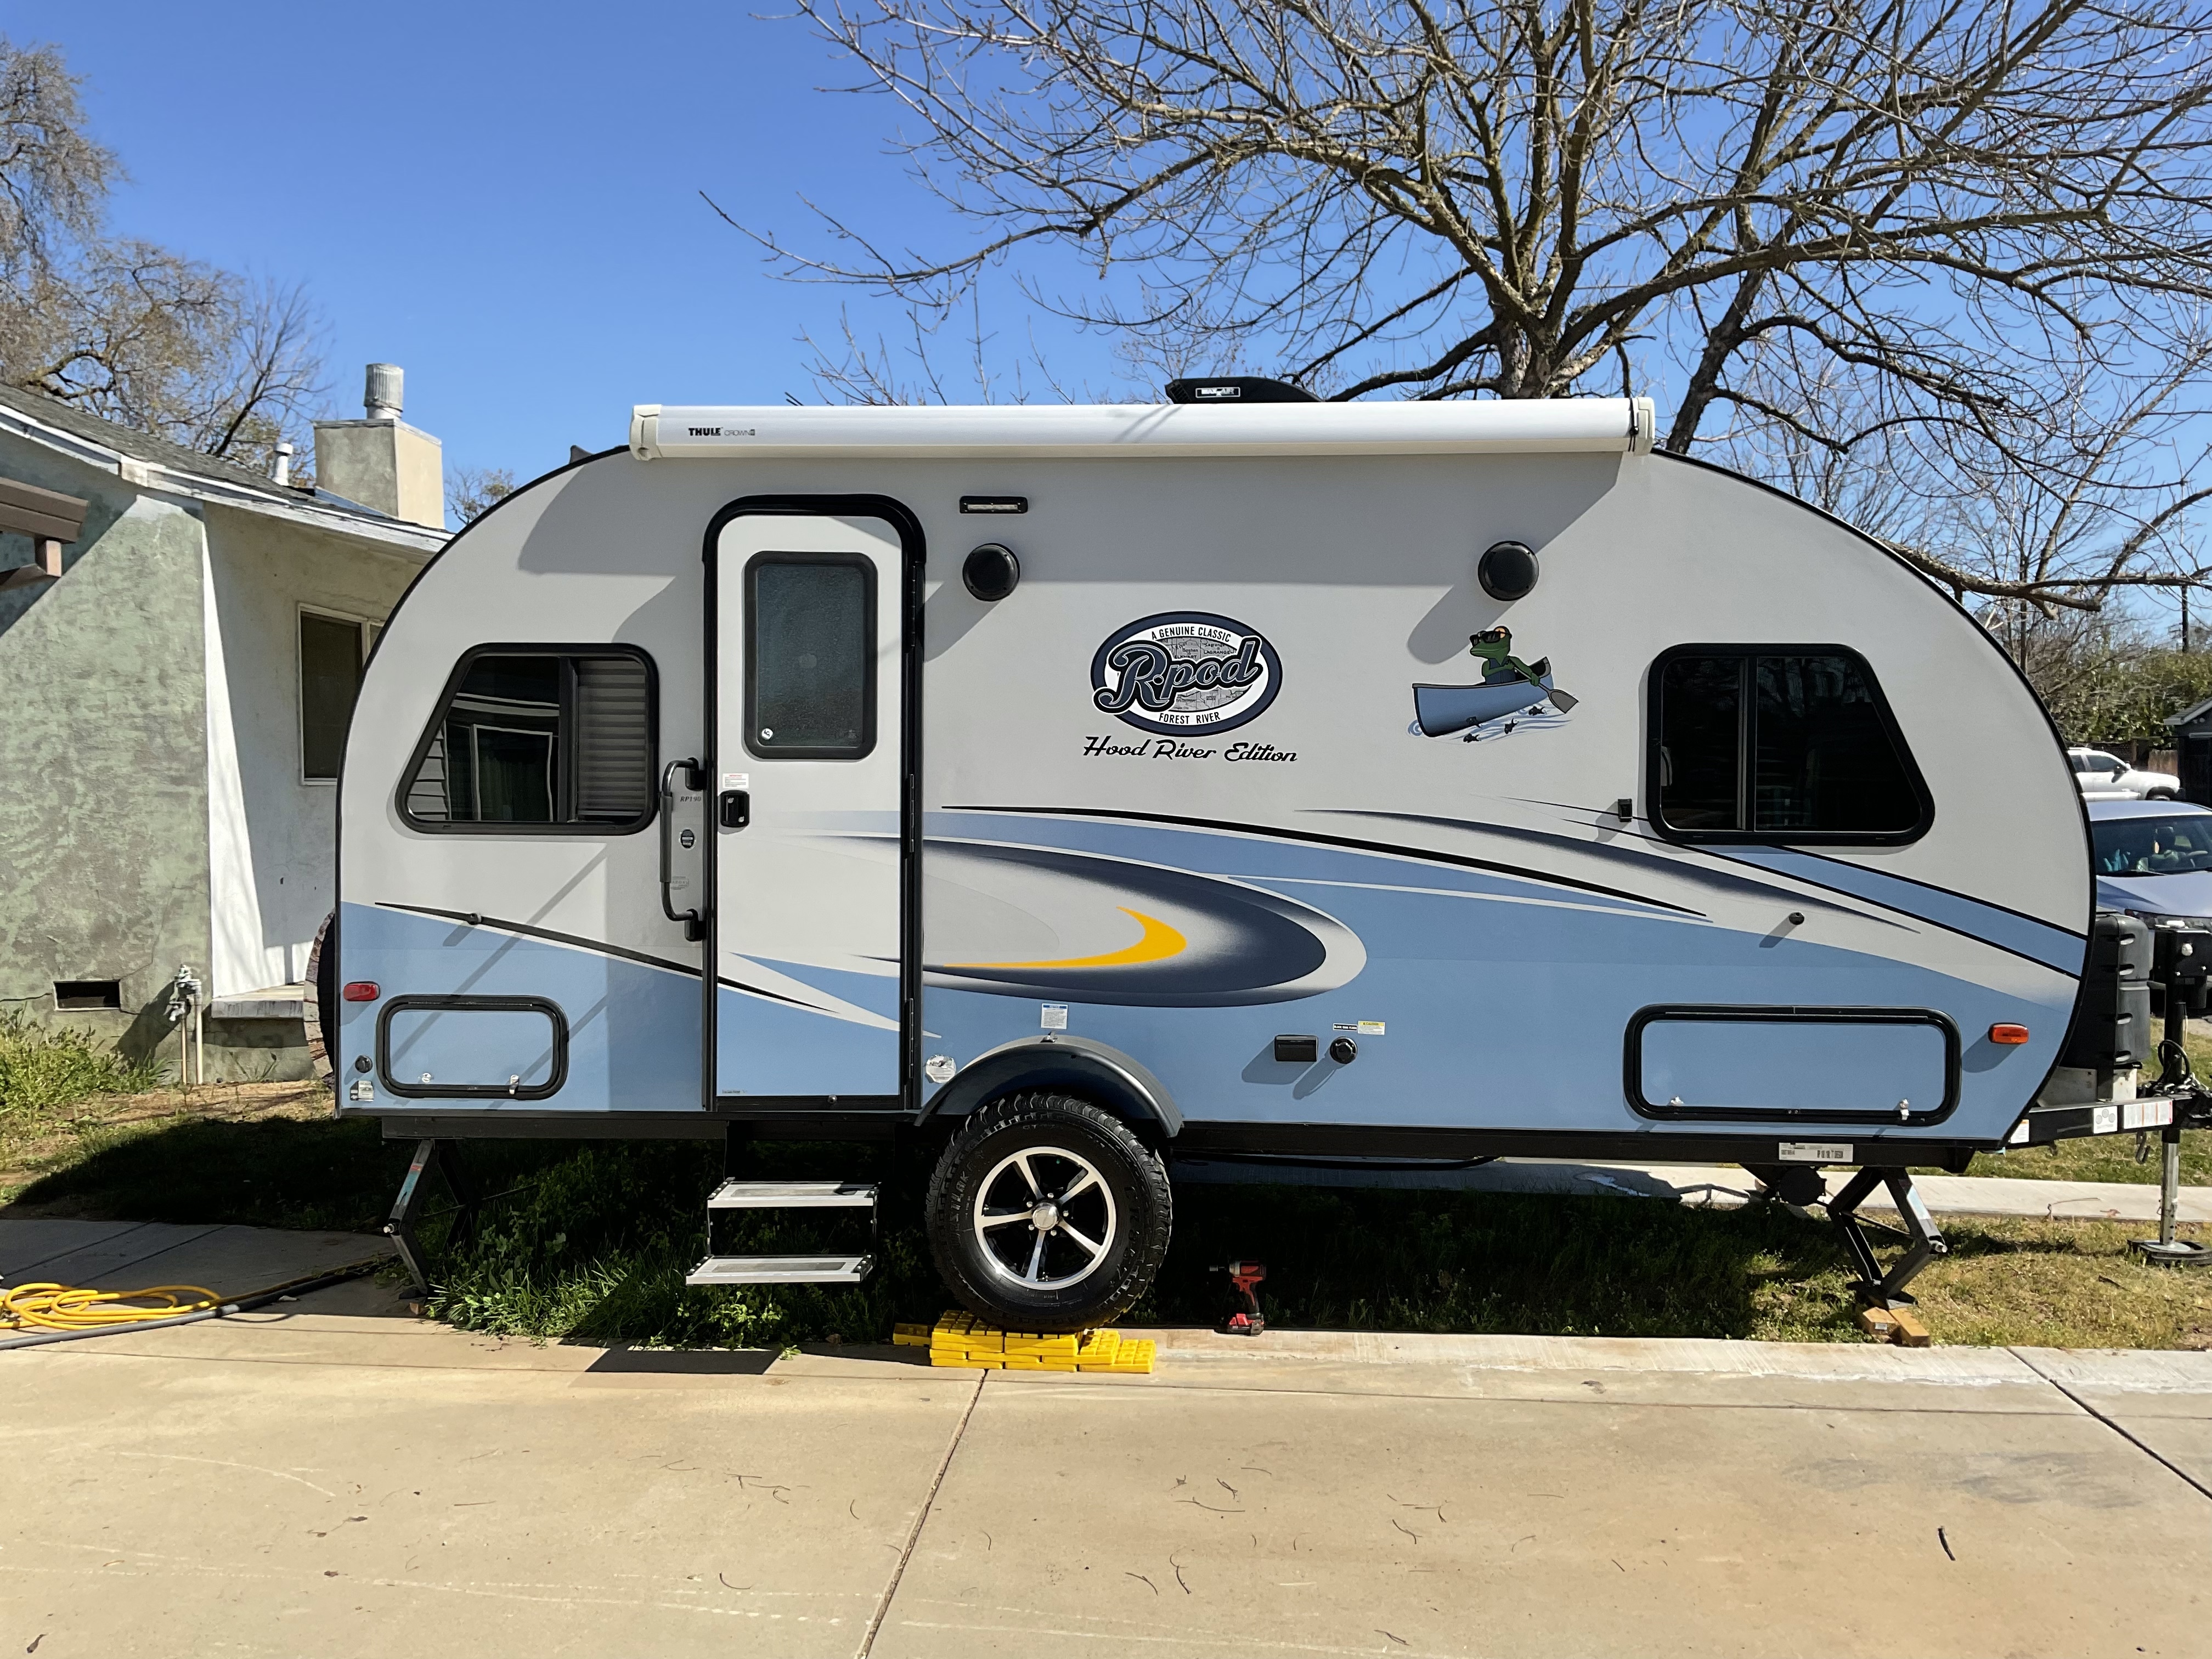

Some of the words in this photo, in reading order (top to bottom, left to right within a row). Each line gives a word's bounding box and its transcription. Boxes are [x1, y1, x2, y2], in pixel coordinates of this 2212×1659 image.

[689, 427, 721, 436] THULE
[1152, 631, 1157, 640] A
[1159, 627, 1195, 638] GENUINE
[1198, 627, 1232, 642] CLASSIC
[1159, 713, 1190, 724] FOREST
[1196, 712, 1221, 724] RIVER
[1083, 735, 1151, 757] Hood
[1153, 738, 1217, 760] River
[1224, 742, 1298, 763] Edition
